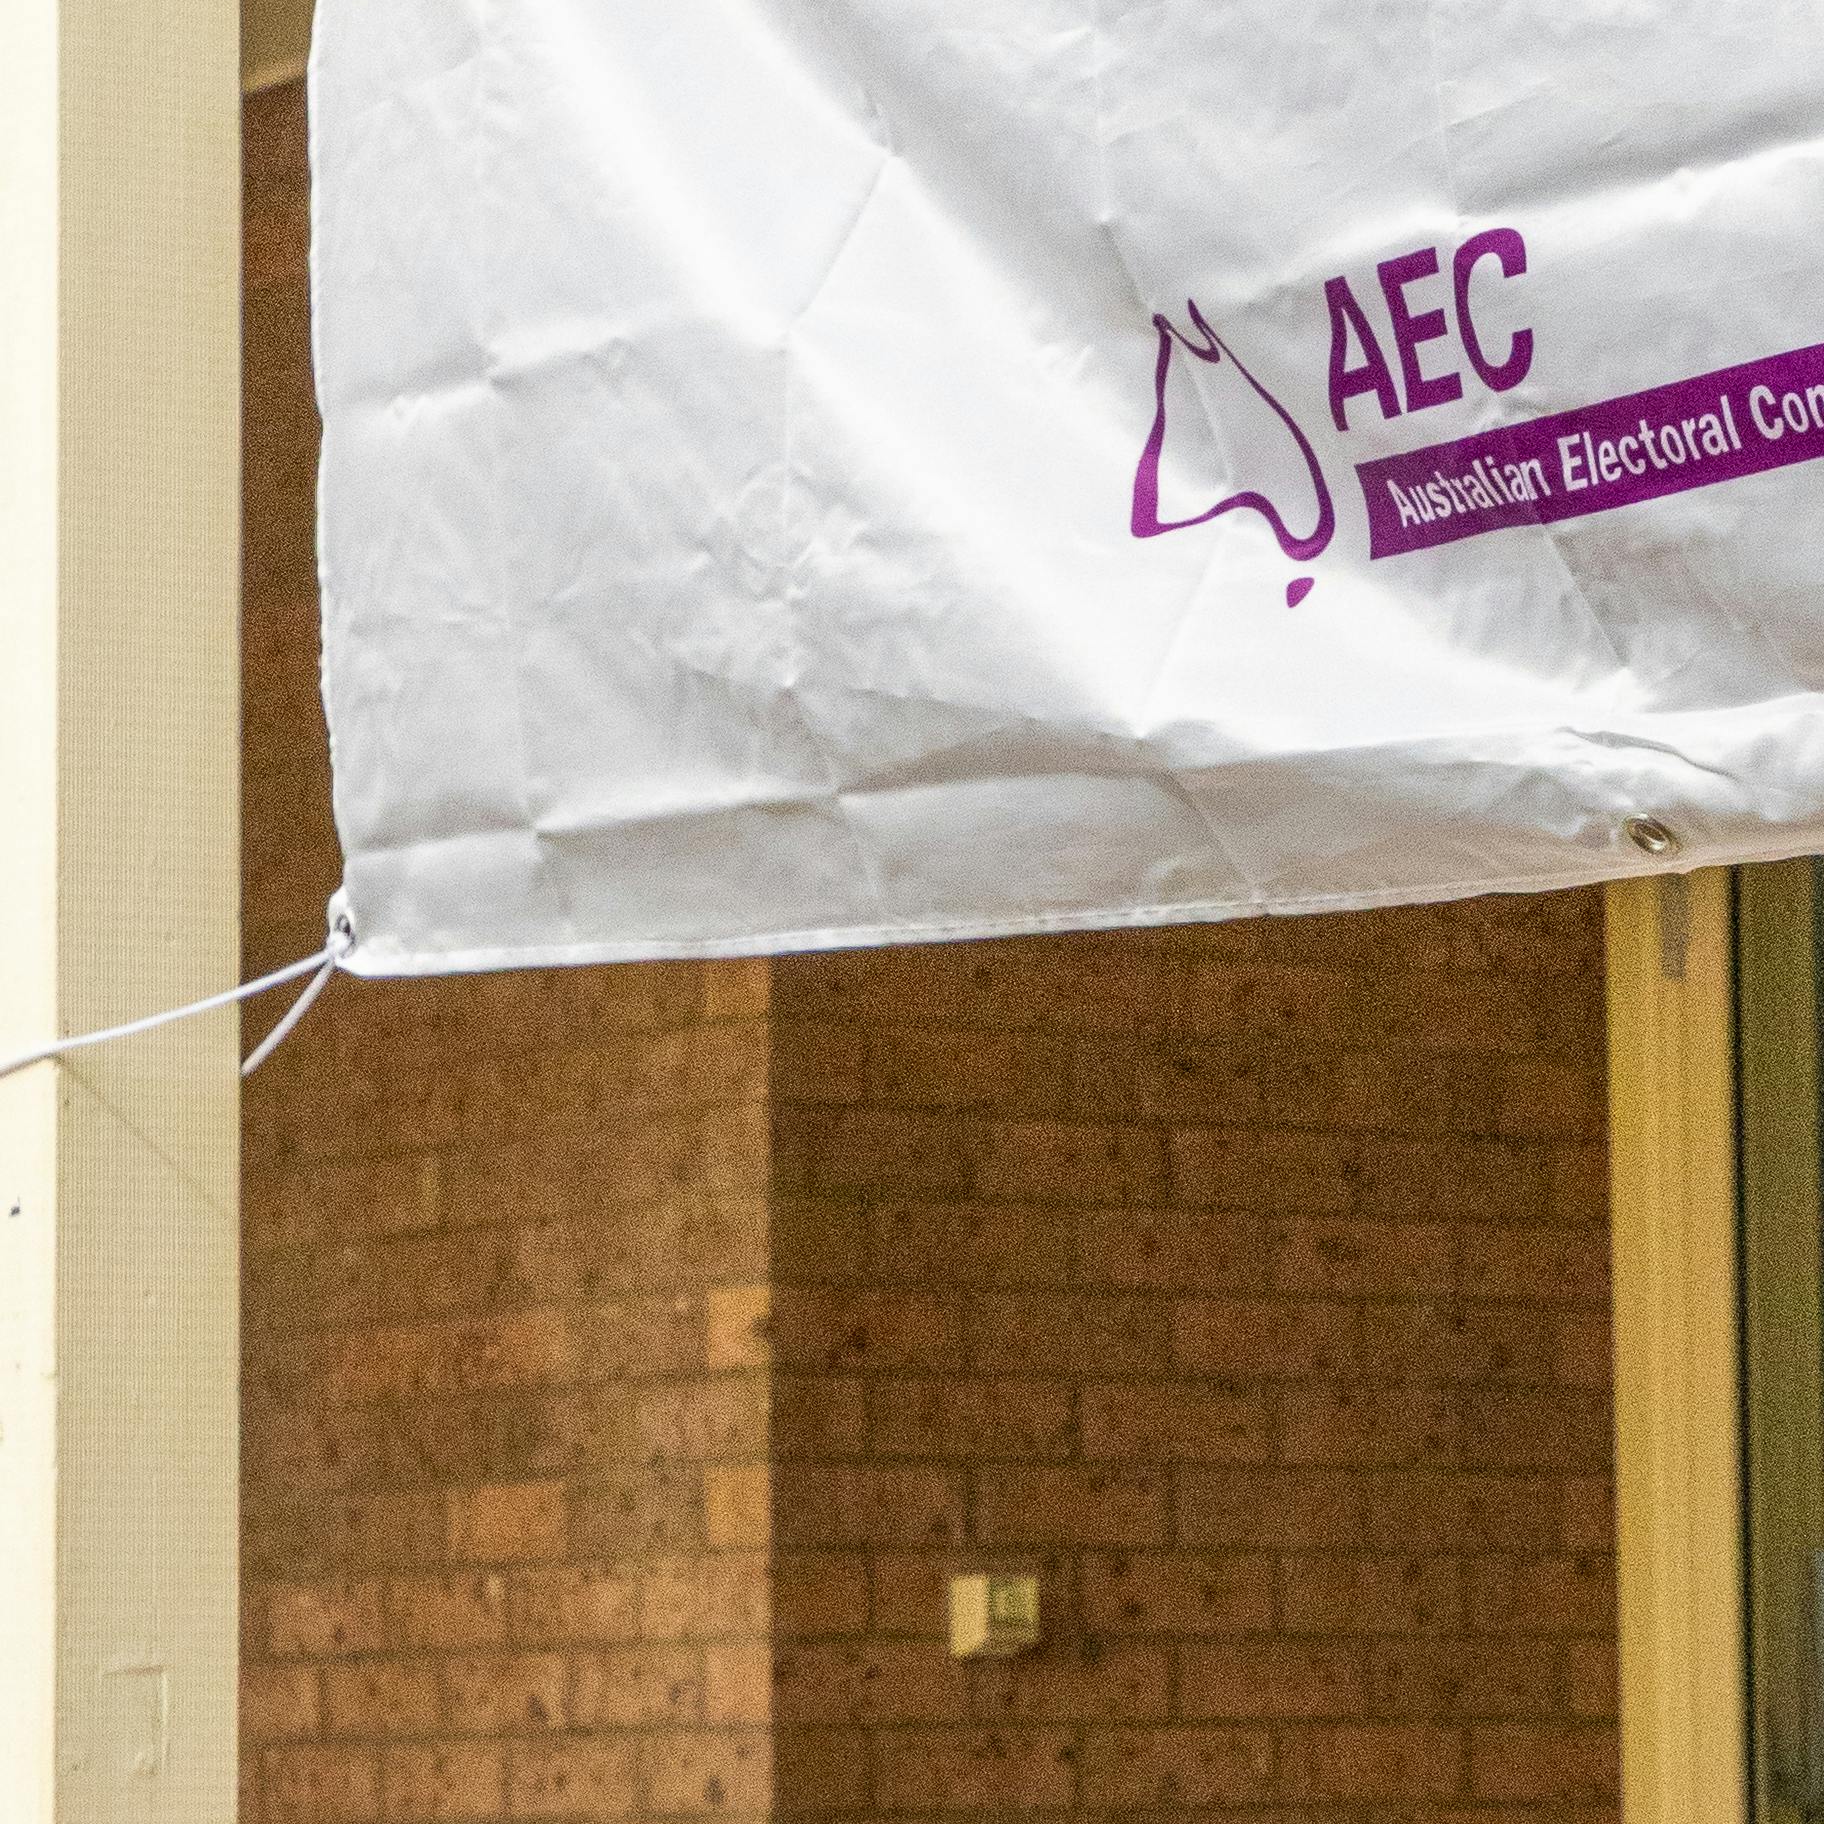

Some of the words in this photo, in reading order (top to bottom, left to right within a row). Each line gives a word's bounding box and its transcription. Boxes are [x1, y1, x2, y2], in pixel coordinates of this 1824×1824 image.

[1325, 228, 1533, 431] AEC
[1390, 454, 1552, 528] Australian
[1558, 393, 1742, 493] Electoral
